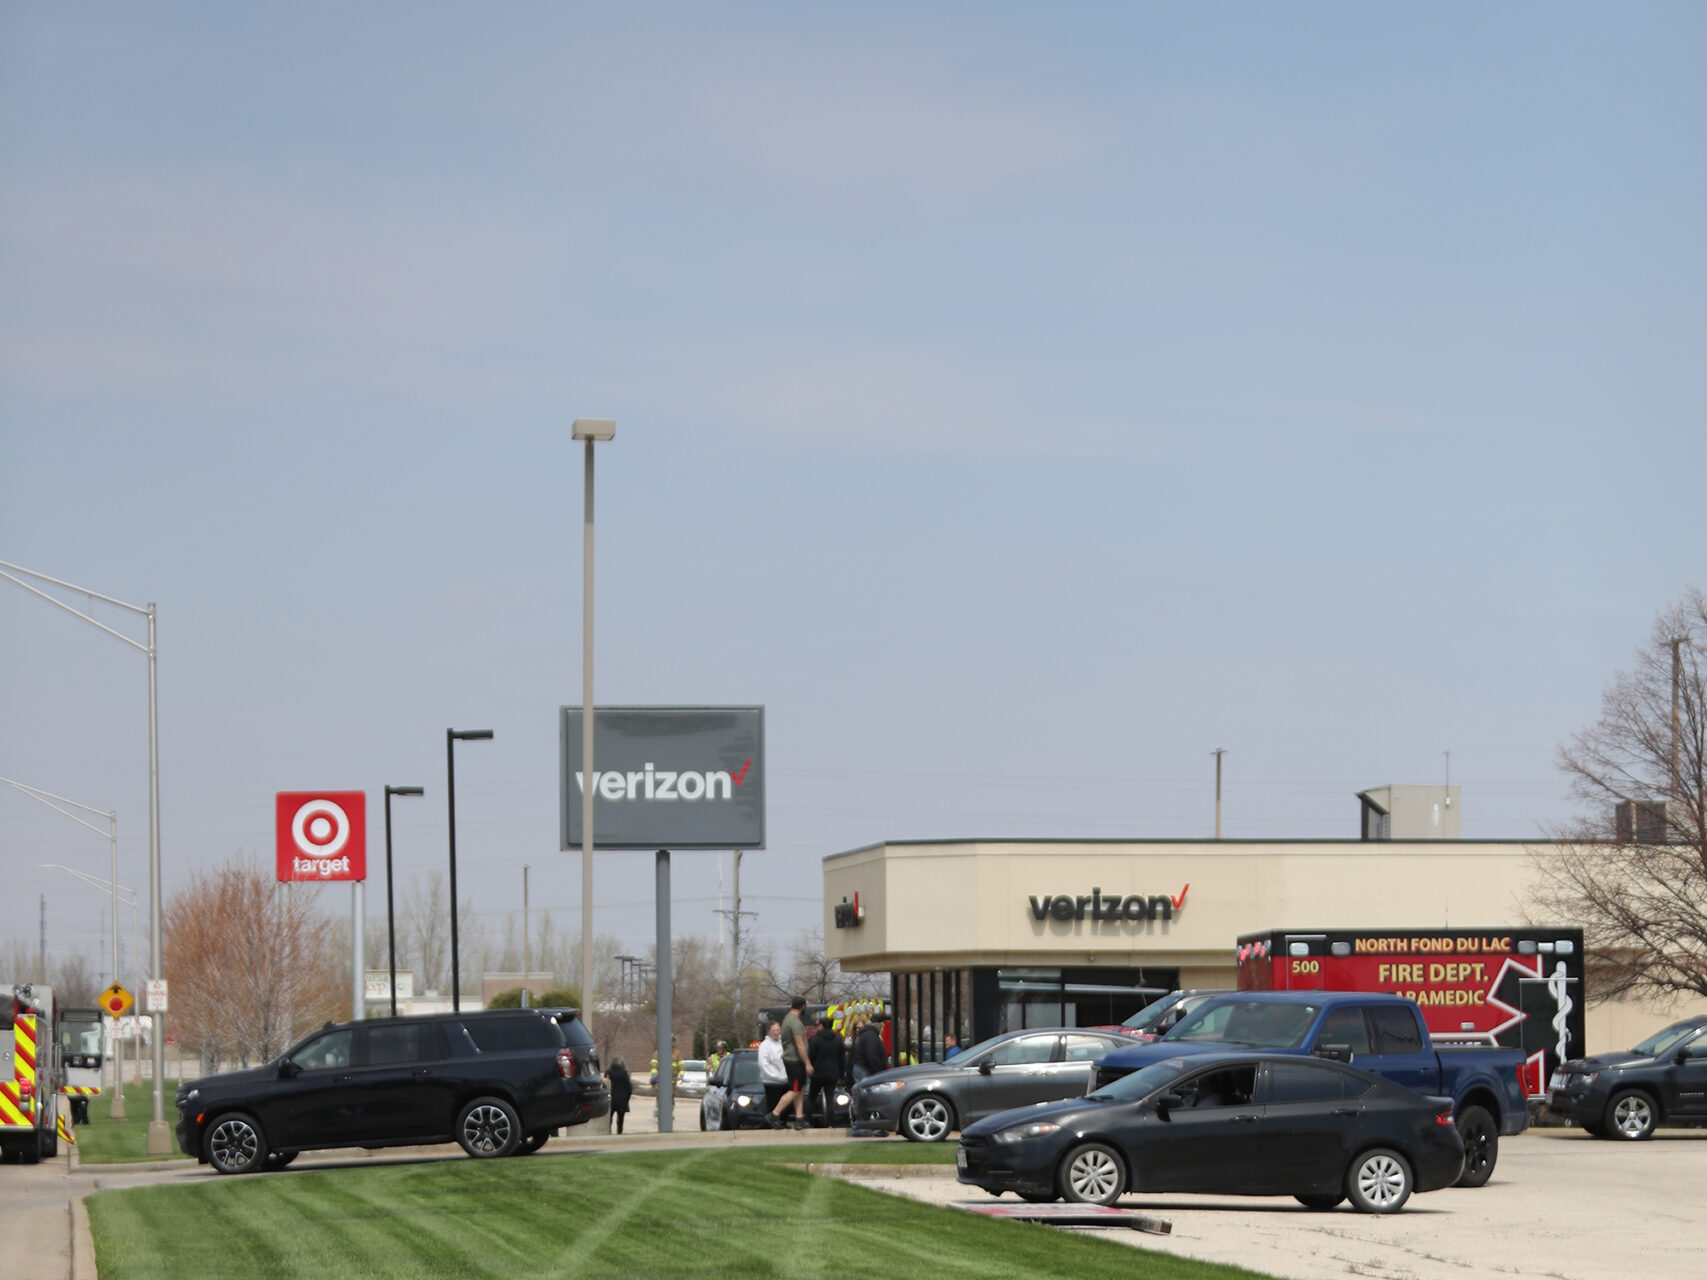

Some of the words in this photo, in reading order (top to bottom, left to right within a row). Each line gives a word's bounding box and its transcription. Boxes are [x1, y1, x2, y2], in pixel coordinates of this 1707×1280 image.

[575, 762, 732, 800] verizon
[292, 855, 350, 875] target
[1028, 887, 1172, 921] verizon
[1355, 938, 1408, 952] NORTH
[1411, 938, 1453, 952] FOND
[1457, 937, 1479, 951] DU
[1482, 937, 1512, 951] LAC
[1292, 960, 1320, 973] 500
[1379, 963, 1425, 983] FIRE
[1429, 963, 1490, 982] DEPT.
